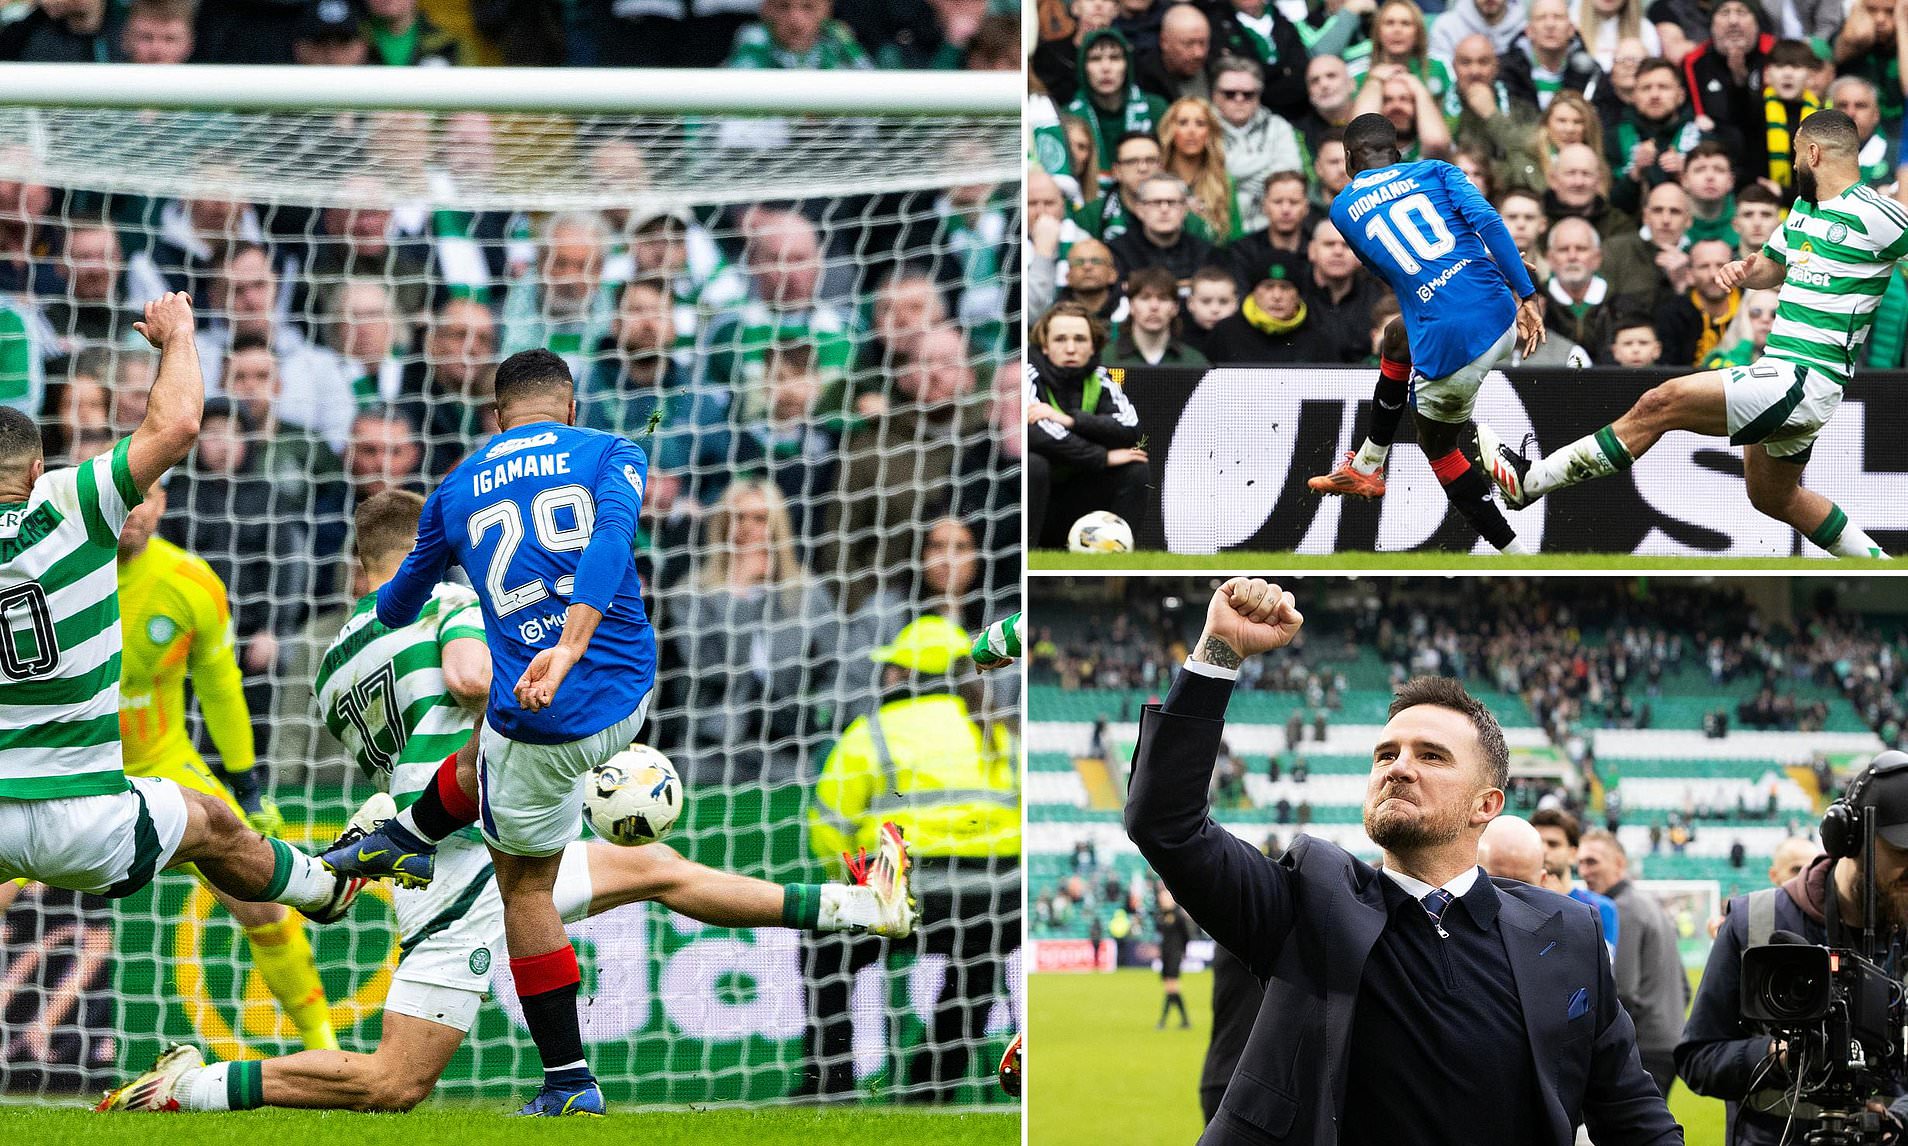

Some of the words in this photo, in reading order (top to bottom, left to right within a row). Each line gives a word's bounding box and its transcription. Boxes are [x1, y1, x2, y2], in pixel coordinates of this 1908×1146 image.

[1347, 178, 1420, 222] DIOMANDE
[1365, 193, 1456, 276] 10
[473, 453, 571, 497] IGAMANE
[467, 484, 597, 619] 29
[337, 658, 406, 776] 17
